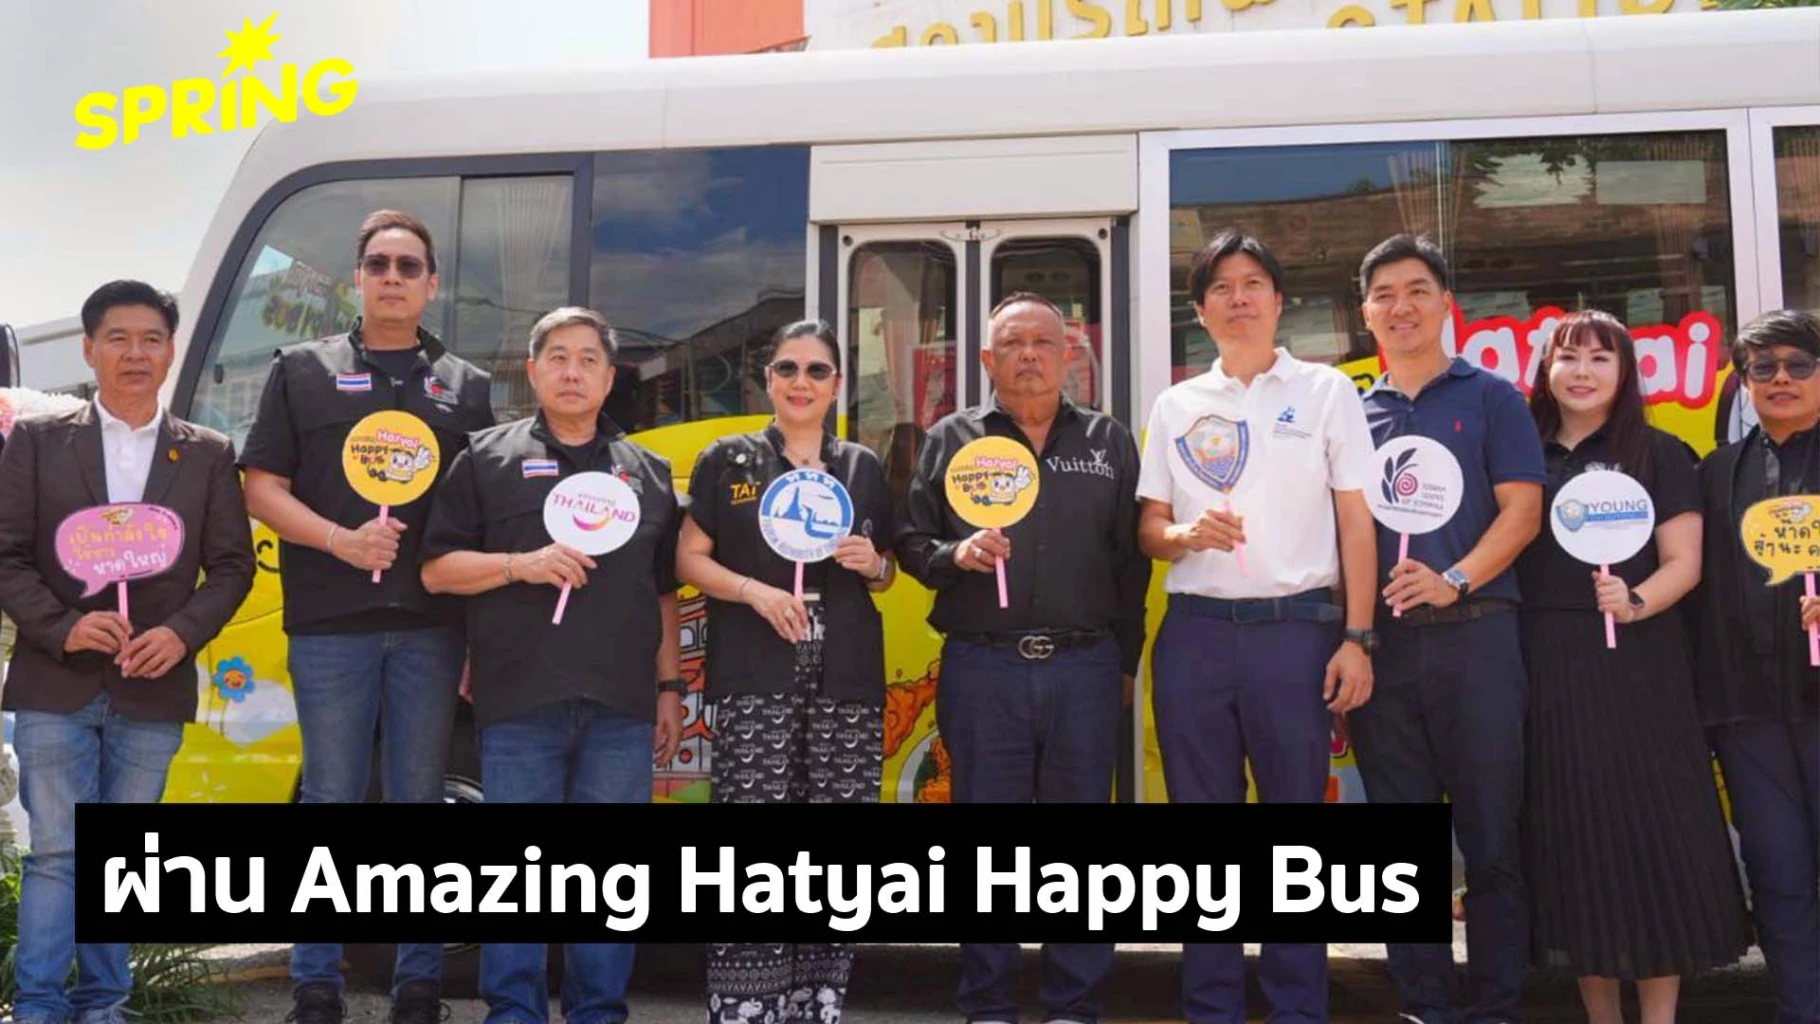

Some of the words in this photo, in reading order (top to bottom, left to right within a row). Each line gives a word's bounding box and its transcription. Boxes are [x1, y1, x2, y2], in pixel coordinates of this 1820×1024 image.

[1441, 312, 1710, 400] atai
[350, 444, 389, 455] Happy
[1046, 456, 1114, 480] Vuitton
[951, 471, 989, 485] Happy
[552, 493, 636, 523] THAILAND
[1590, 499, 1648, 513] YOUNG
